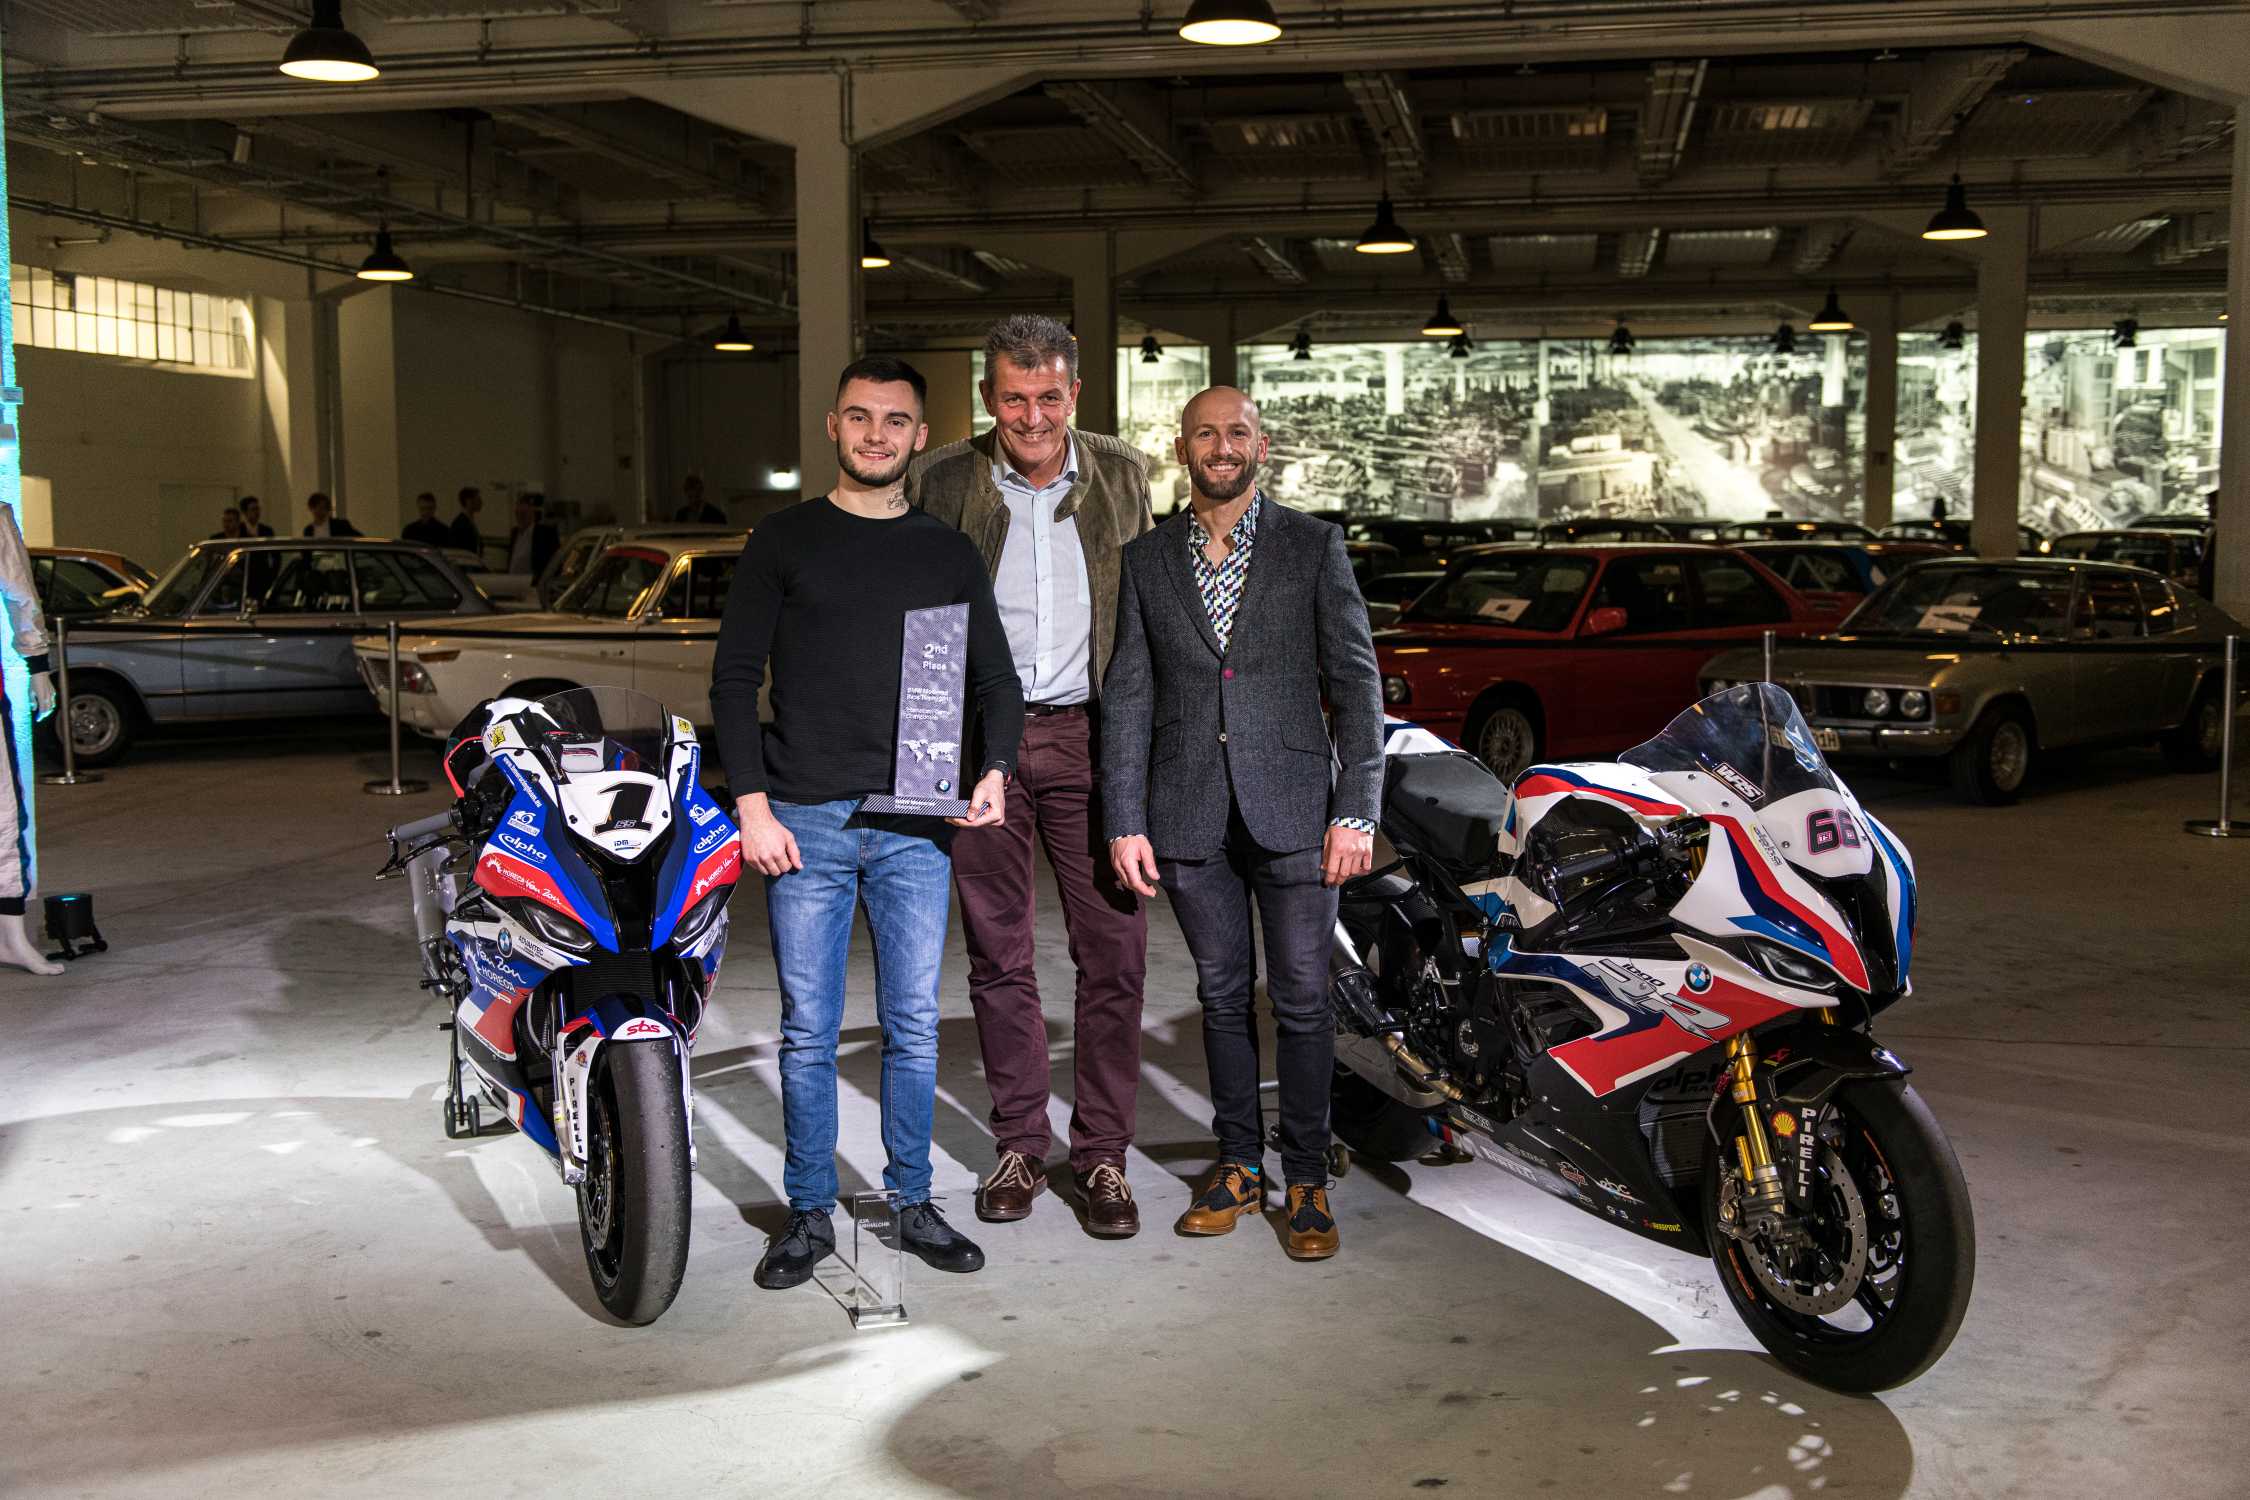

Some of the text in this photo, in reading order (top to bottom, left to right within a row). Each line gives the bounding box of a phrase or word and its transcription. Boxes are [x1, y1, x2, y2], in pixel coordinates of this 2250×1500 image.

[924, 643, 948, 659] 2nd
[922, 660, 947, 671] Place
[1716, 764, 1762, 799] WRS
[593, 781, 655, 837] 1
[697, 823, 727, 850] alpha
[1807, 809, 1860, 855] 66
[503, 835, 548, 860] alpha
[503, 867, 526, 884] HORECA
[626, 1020, 660, 1036] sbs
[569, 1077, 583, 1154] PIRELLI
[1798, 1107, 1817, 1198] PIRELLI
